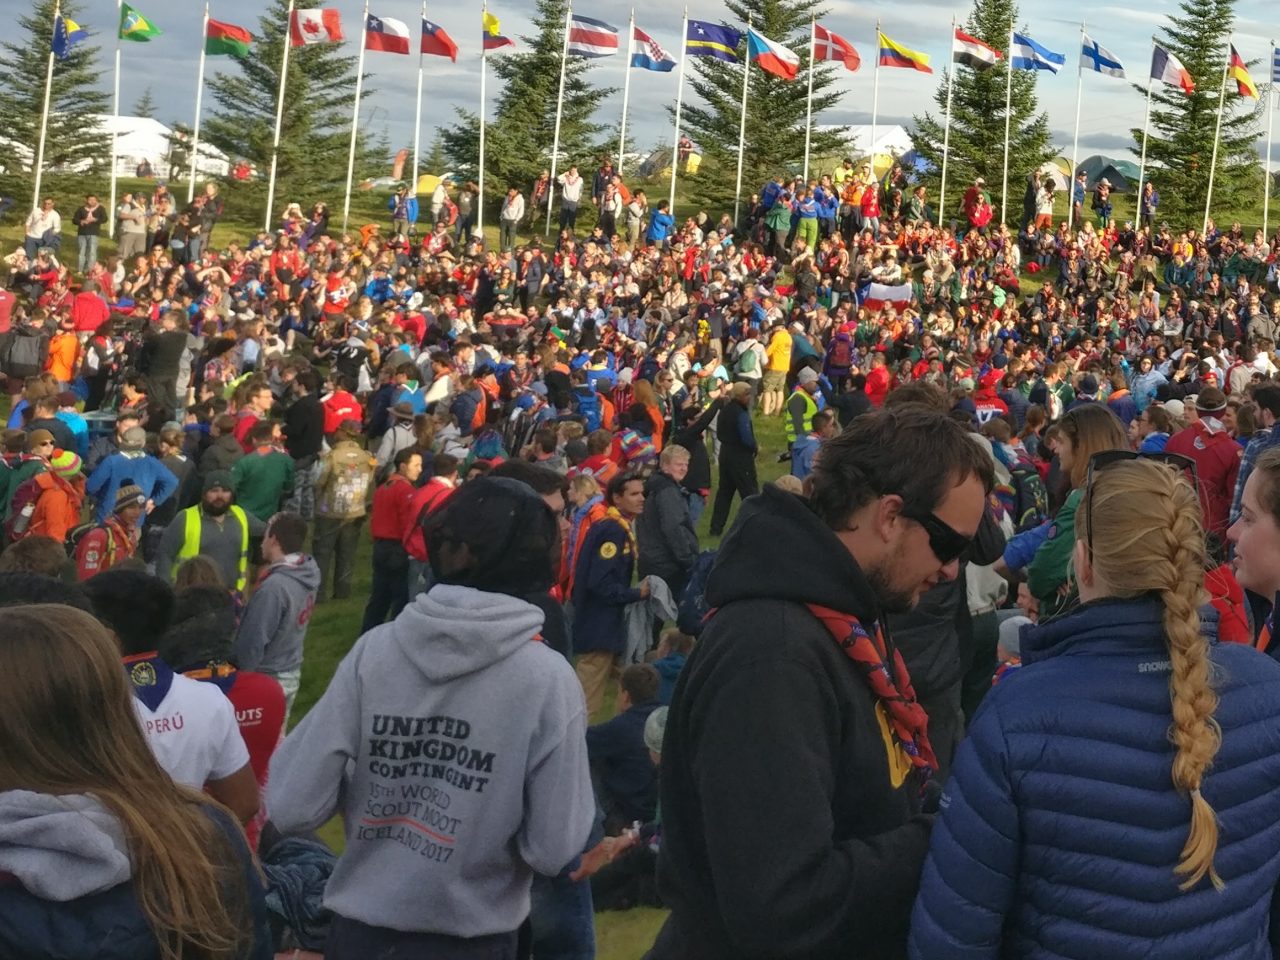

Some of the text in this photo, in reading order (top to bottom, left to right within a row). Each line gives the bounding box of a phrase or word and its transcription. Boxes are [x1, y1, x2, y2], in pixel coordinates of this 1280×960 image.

[146, 711, 185, 734] PERÚ
[372, 714, 471, 739] UNITED
[369, 739, 496, 773] KINGDOM
[369, 760, 488, 792] CONTINGENT
[400, 784, 450, 810] WORLD
[364, 800, 462, 835] SCOUT MOOT
[357, 825, 455, 863] ICELAND 2017
